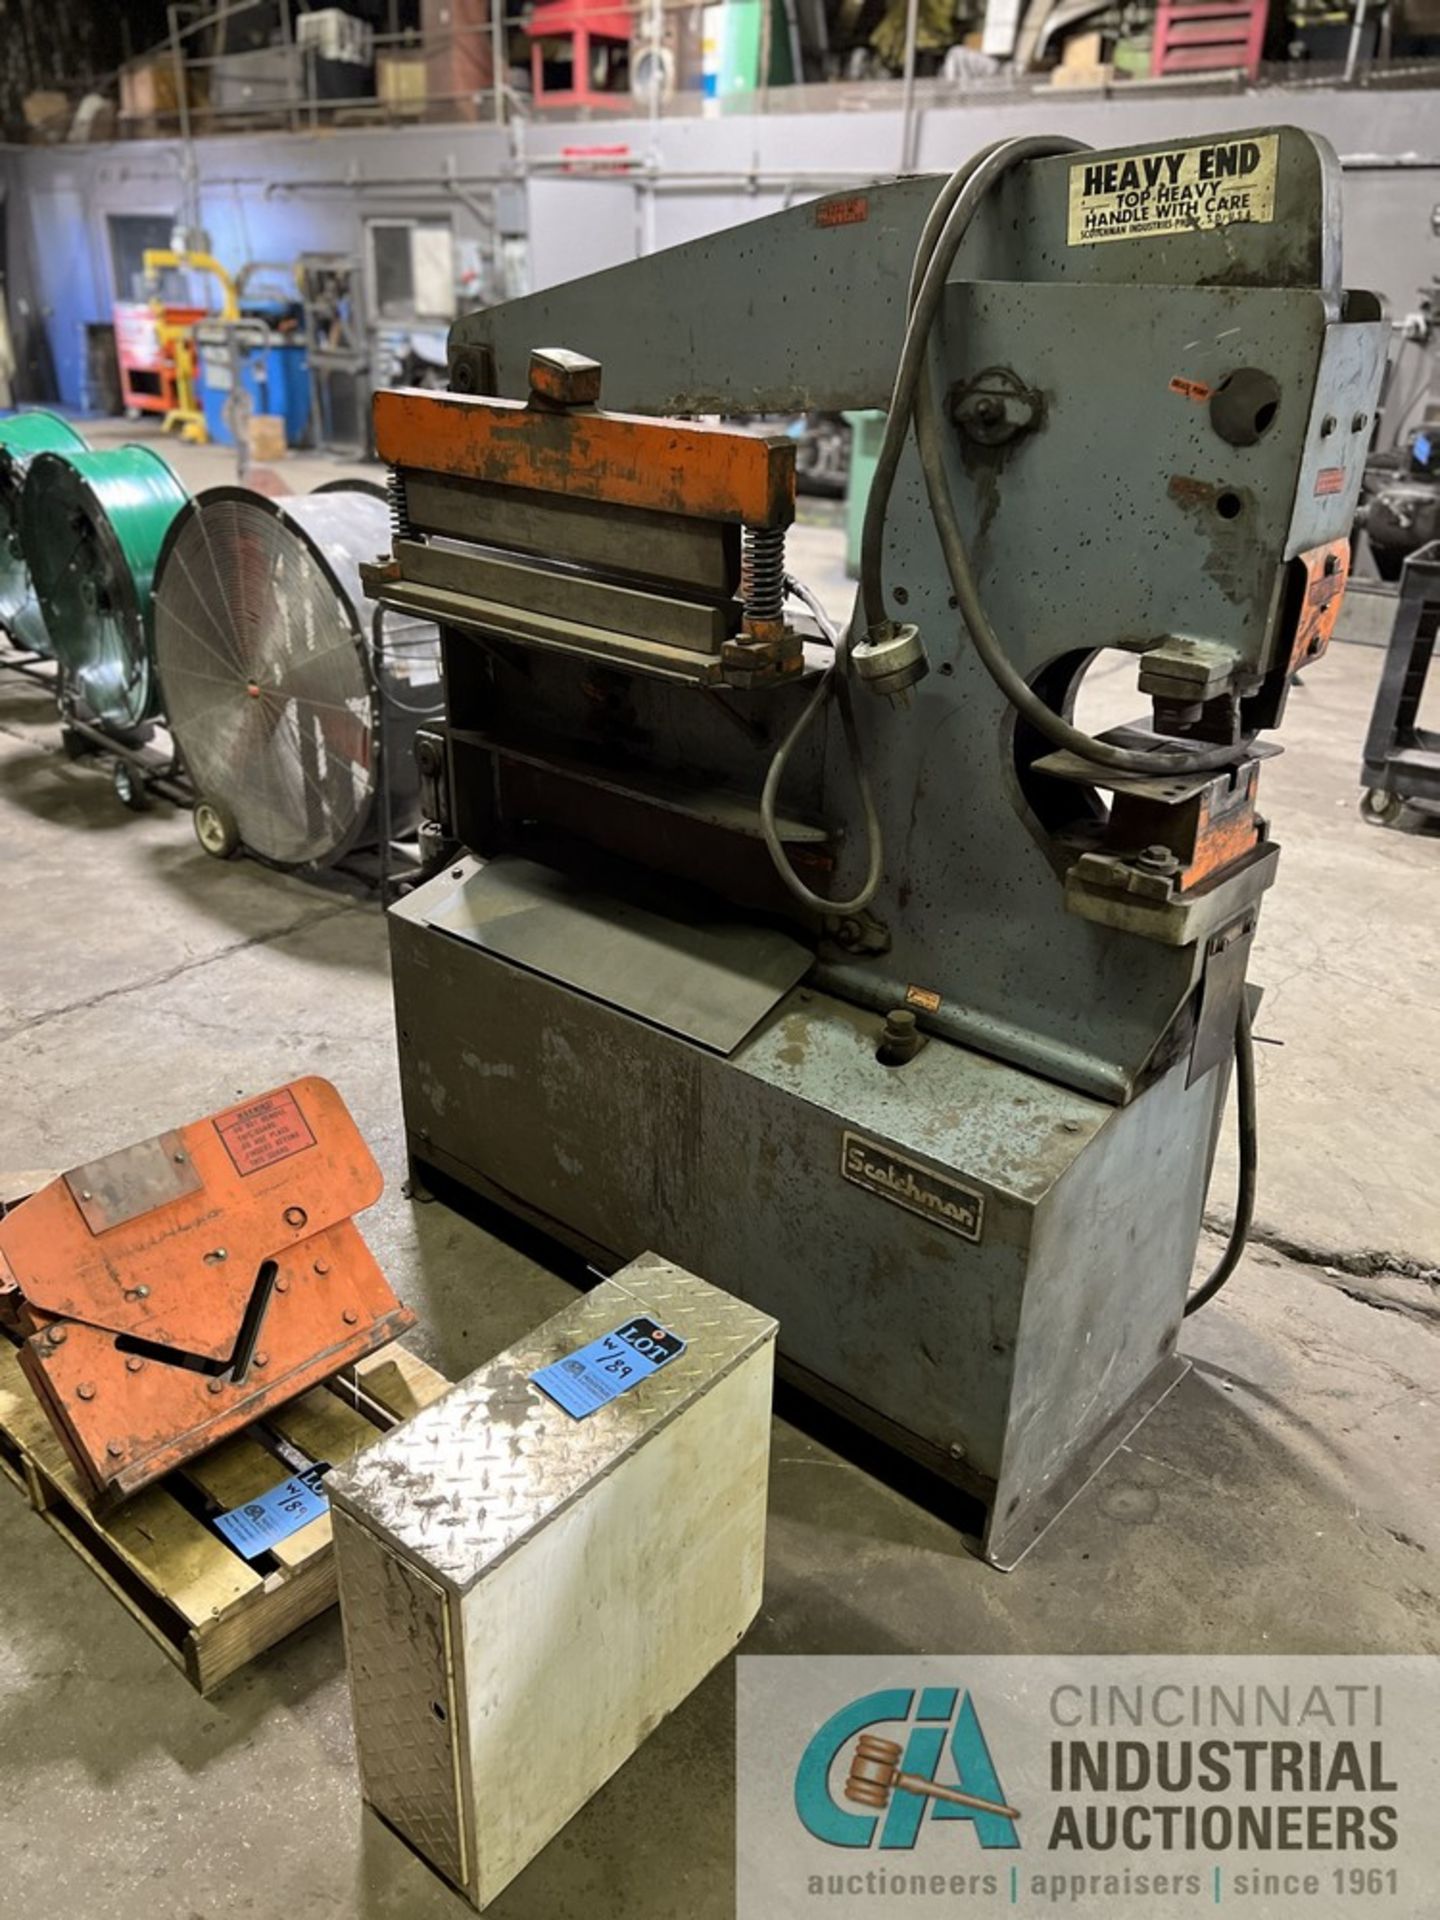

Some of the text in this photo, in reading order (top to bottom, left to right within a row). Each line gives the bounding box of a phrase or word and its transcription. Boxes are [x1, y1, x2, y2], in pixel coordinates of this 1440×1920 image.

[1083, 143, 1261, 196] HEAVY END
[1085, 193, 1250, 228] HANDLE WITH CARE
[1116, 181, 1222, 208] TOP HEAVY
[847, 1147, 975, 1228] Scotchman
[620, 1326, 668, 1360] LOT
[303, 1470, 324, 1494] LO
